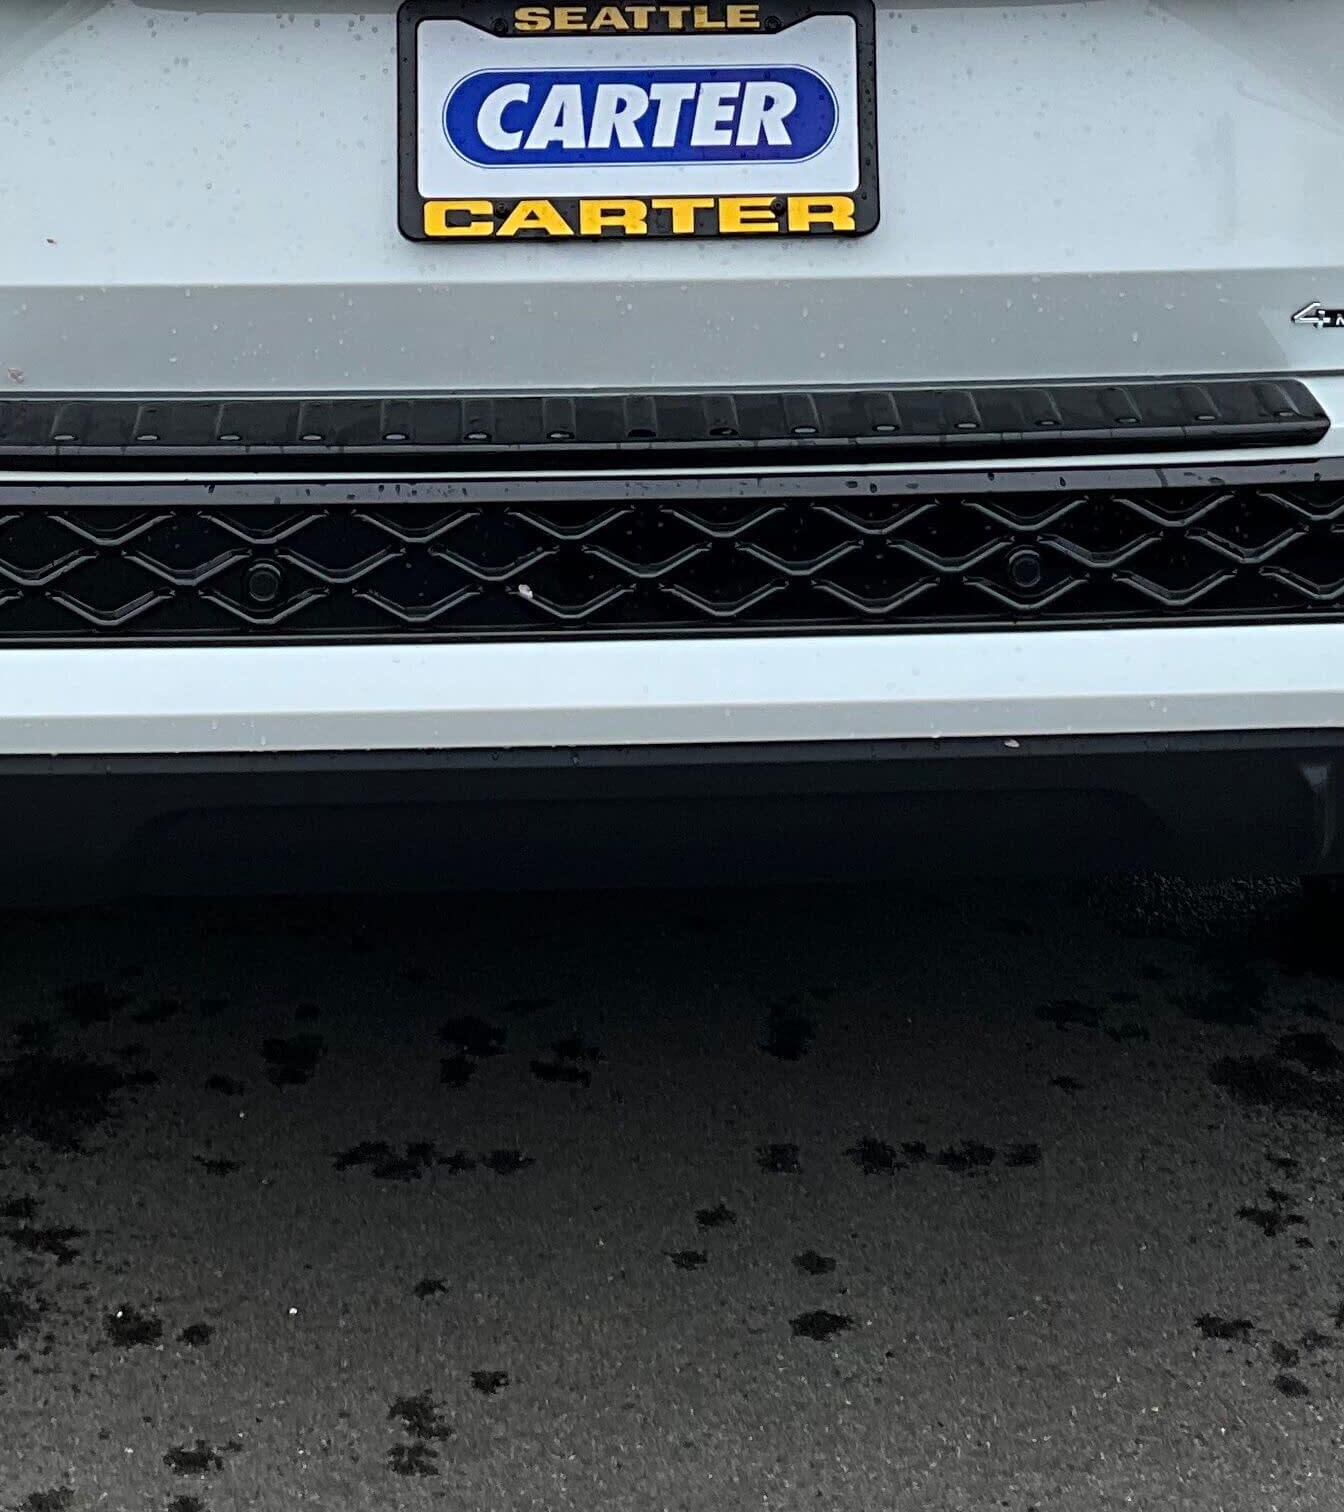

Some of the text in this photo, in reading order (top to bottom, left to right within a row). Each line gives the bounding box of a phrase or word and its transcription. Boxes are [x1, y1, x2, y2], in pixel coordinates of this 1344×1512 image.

[514, 4, 760, 32] SEATTLE
[476, 80, 797, 151] CARTER
[423, 195, 856, 237] CARTER
